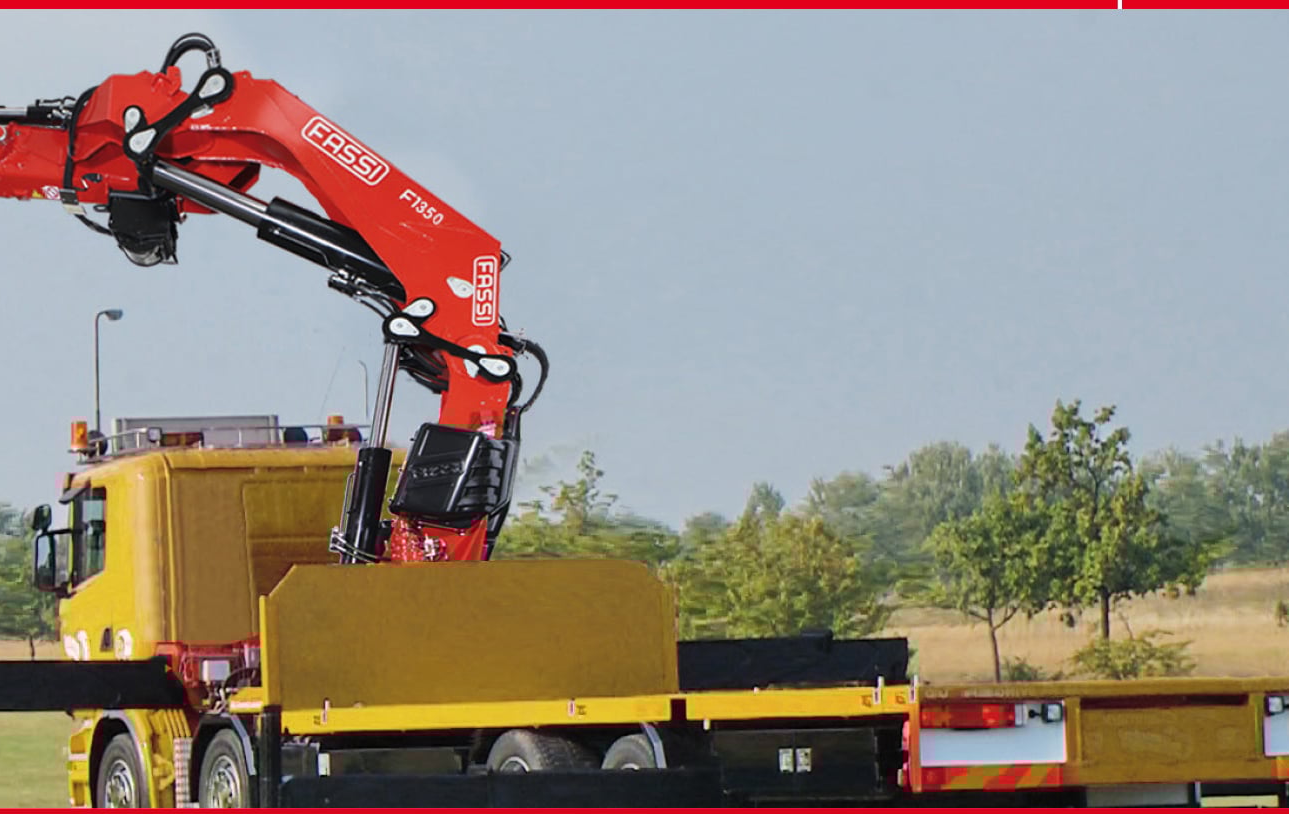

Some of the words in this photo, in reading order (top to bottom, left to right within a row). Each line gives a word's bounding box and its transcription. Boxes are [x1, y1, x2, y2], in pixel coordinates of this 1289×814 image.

[307, 121, 383, 180] FASSI
[399, 188, 444, 225] F1350
[476, 260, 494, 322] FASSI
